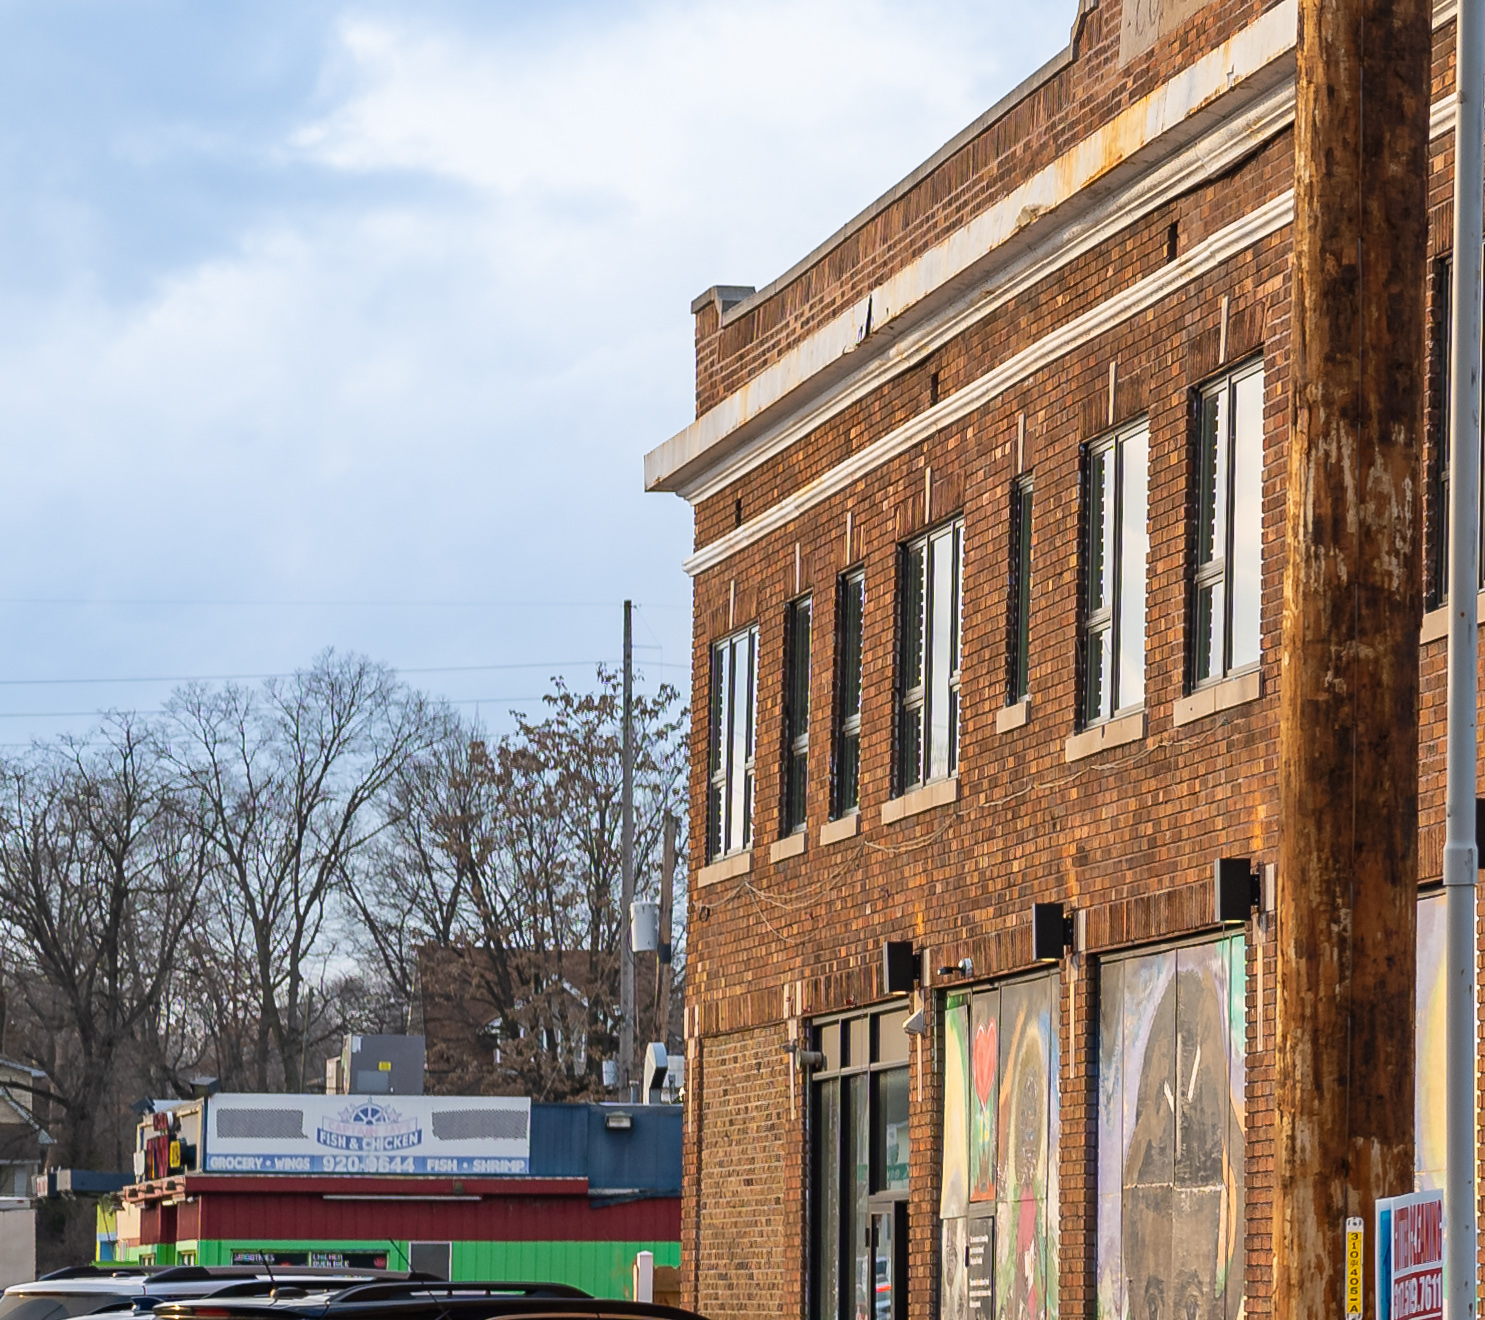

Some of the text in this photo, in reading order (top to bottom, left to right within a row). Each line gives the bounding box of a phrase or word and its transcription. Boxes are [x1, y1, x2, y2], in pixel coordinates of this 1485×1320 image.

[320, 1131, 418, 1150] FISH & CHICKEN
[210, 1157, 310, 1170] GROCERY WINGS
[426, 1159, 526, 1173] FISH SHRIMP
